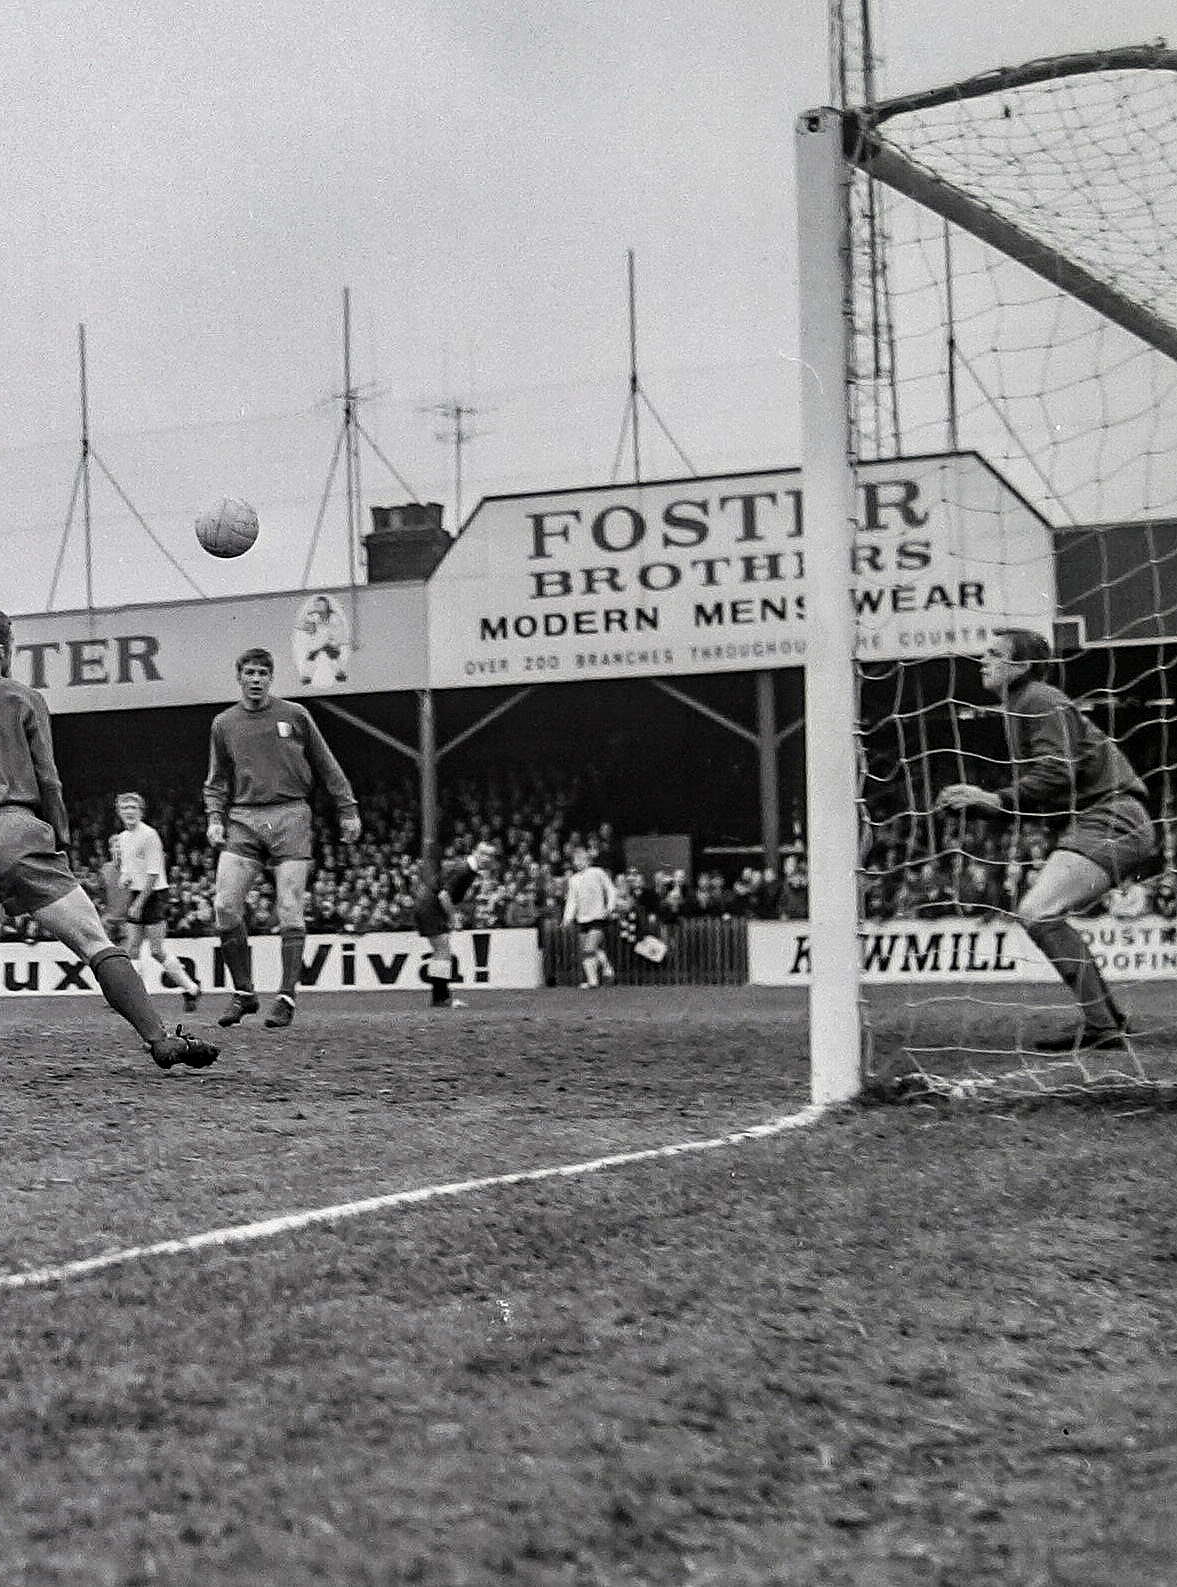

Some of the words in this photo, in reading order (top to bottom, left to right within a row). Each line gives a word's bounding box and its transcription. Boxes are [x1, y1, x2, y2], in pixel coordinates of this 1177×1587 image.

[528, 540, 932, 600] BROTHRS
[480, 606, 659, 642] MODERN
[850, 580, 985, 616] WEAR
[464, 658, 509, 676] OVER
[523, 654, 560, 671] 200
[575, 648, 674, 669] BRANCHES
[690, 640, 807, 662] THROUGHOU
[855, 632, 882, 651] HE
[898, 626, 988, 648] COUNTR
[788, 932, 1017, 974] KWMILL
